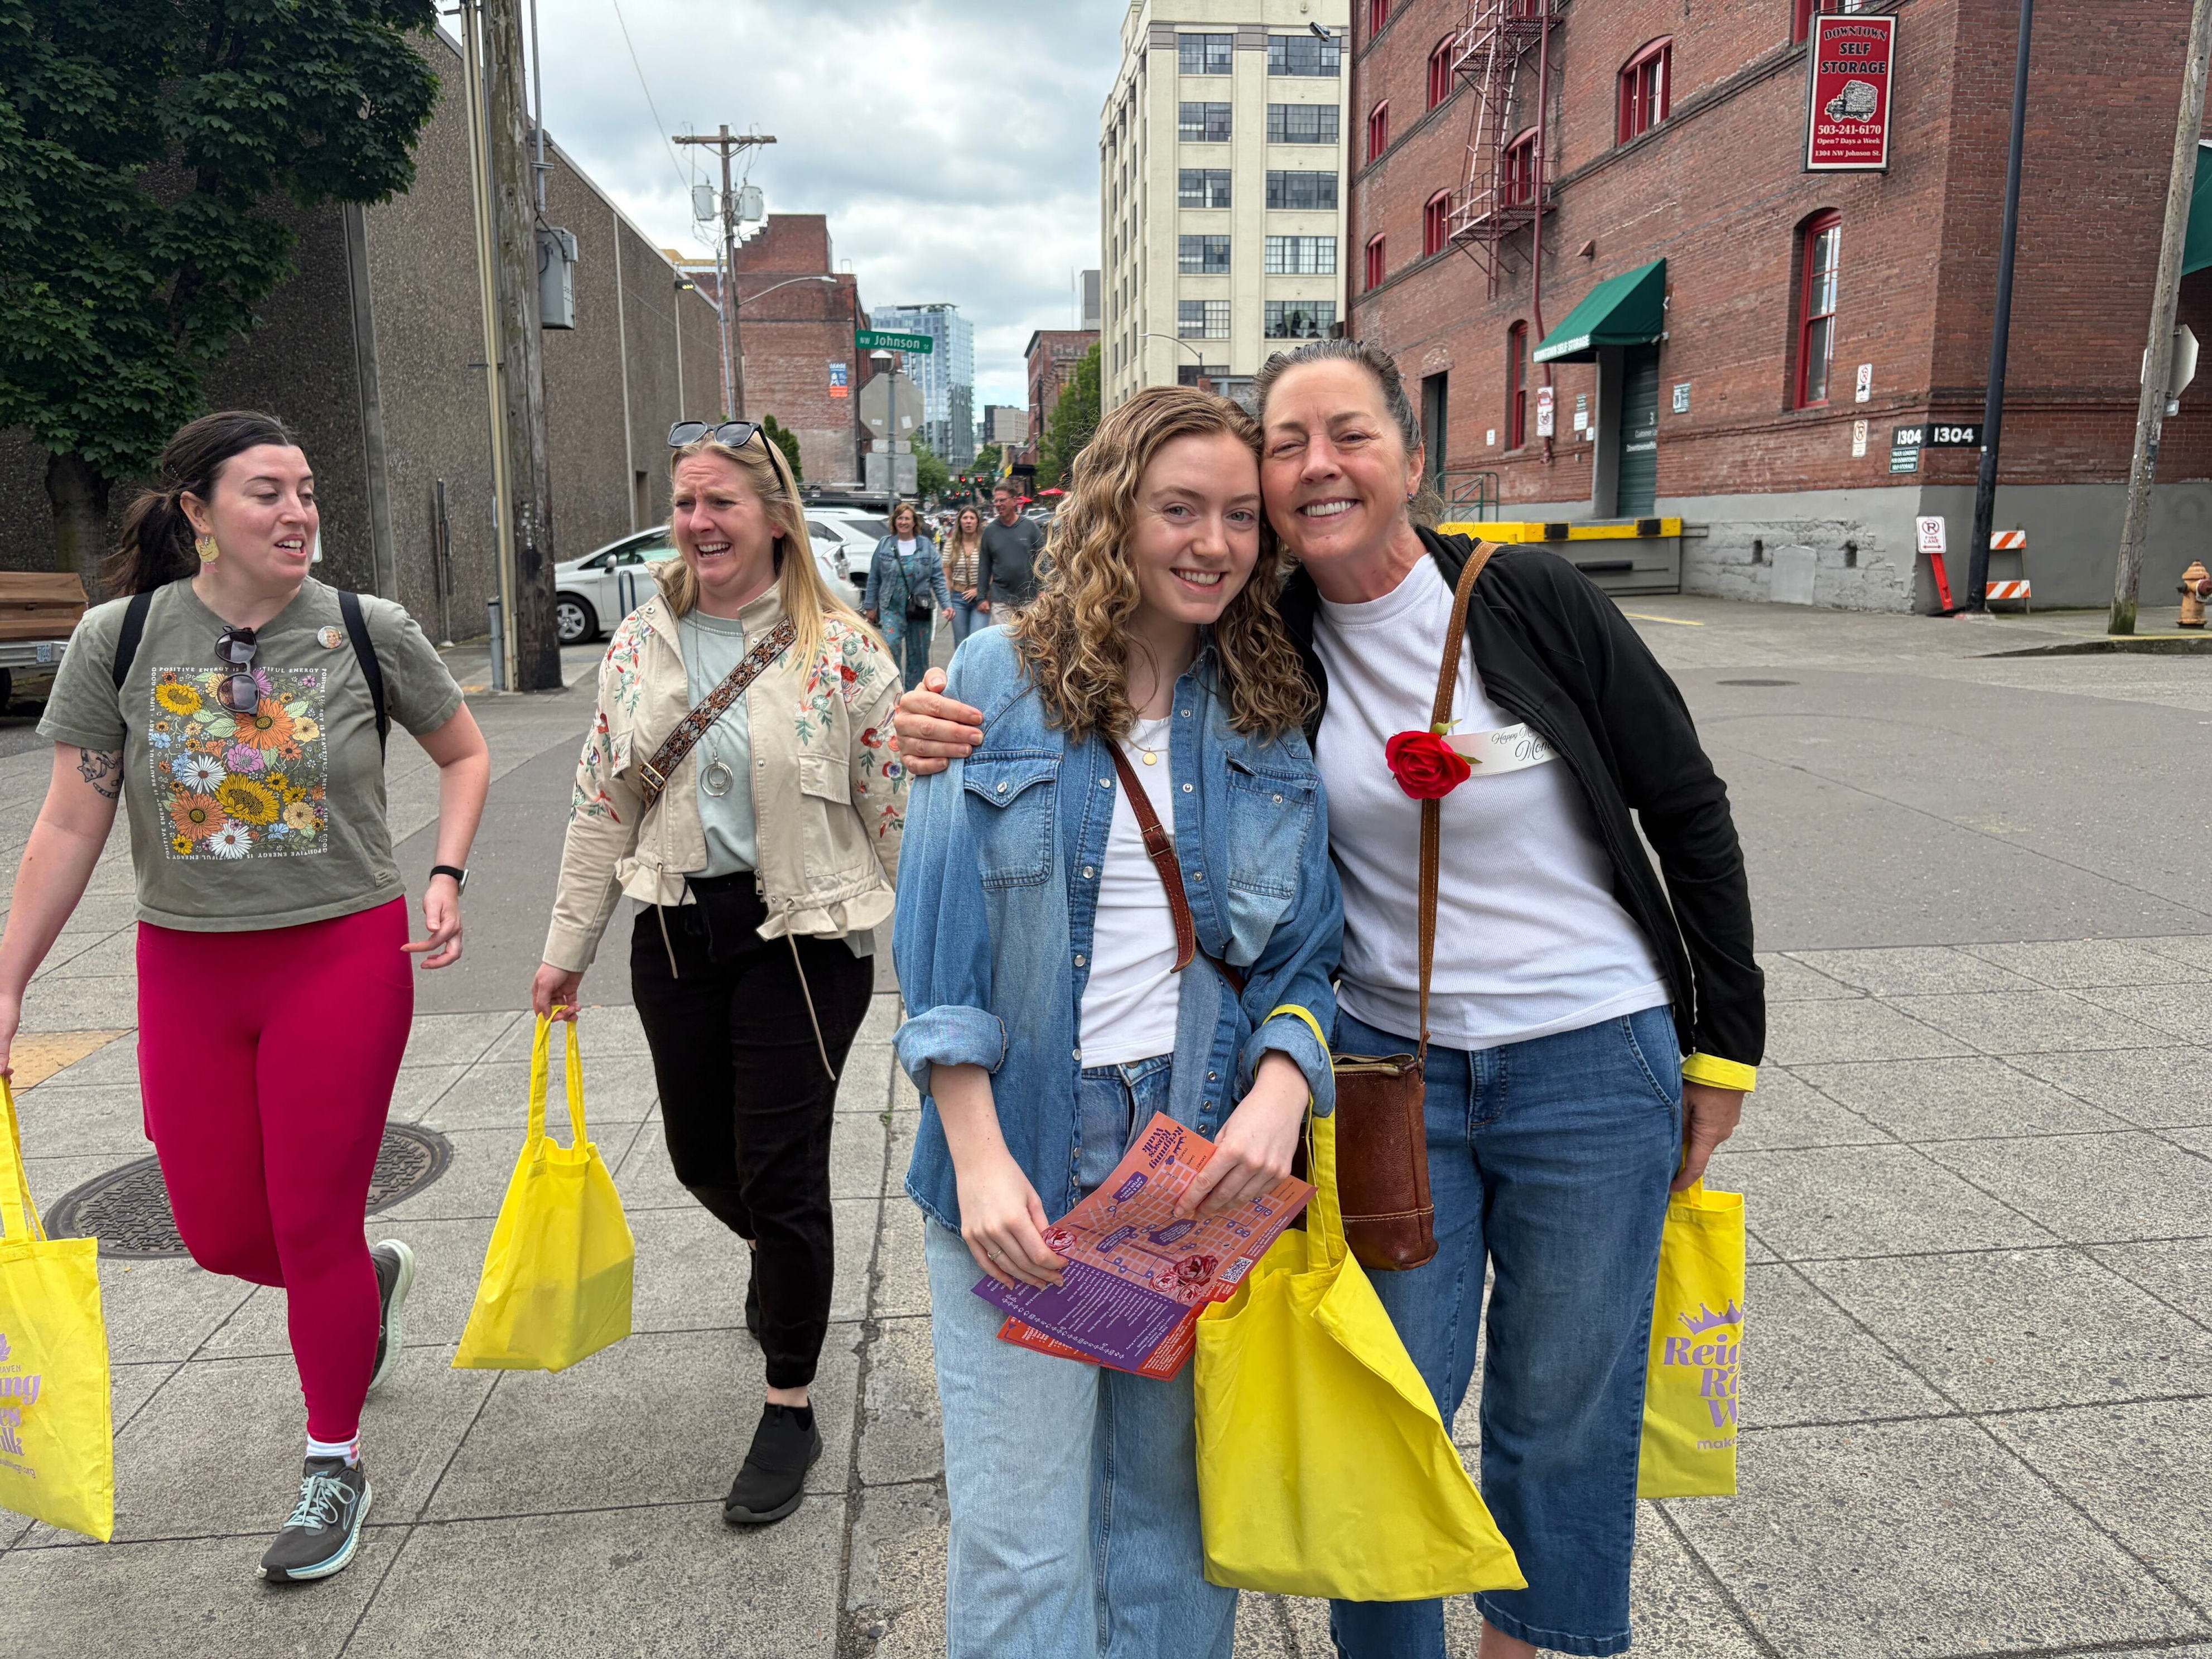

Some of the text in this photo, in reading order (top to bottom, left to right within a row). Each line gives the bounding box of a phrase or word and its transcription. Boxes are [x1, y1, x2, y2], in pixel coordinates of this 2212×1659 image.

[1824, 26, 1887, 41] DOWNTOWN
[1839, 42, 1871, 55] SELF
[1820, 61, 1886, 74] STORAGE
[1818, 125, 1881, 134] 503-241-6170
[874, 335, 920, 349] Johnson
[1897, 429, 1922, 445] 1304
[1934, 427, 1974, 443] 1304
[1491, 732, 1517, 745] Happy
[1141, 1127, 1164, 1152] Walk
[1149, 1129, 1171, 1158] Roses
[1149, 1126, 1184, 1169] Reigning
[1120, 1176, 1141, 1198] AFTER PARTY
[1137, 1335, 1148, 1348] BEGINS
